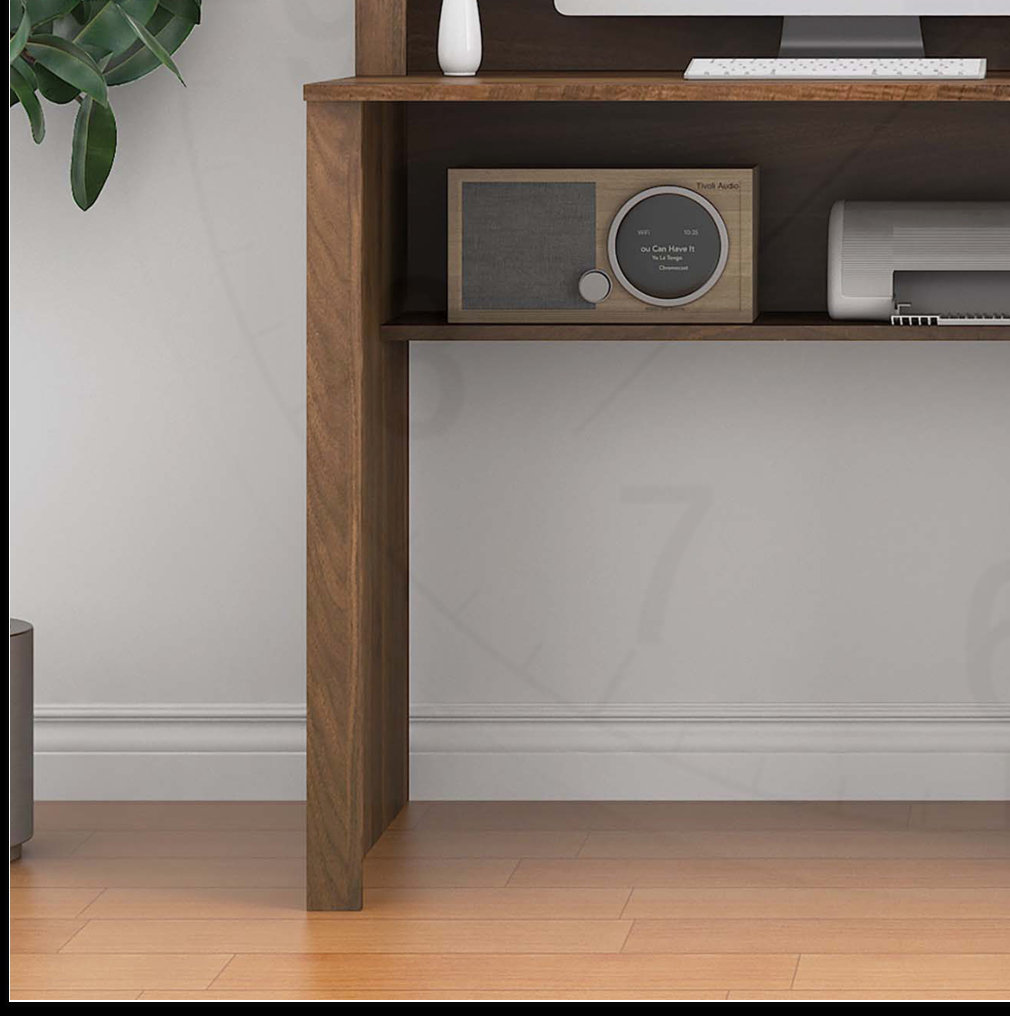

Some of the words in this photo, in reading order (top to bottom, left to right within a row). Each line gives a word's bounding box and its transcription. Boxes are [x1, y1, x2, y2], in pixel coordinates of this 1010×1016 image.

[697, 182, 717, 190] Tivoli
[717, 182, 740, 190] Audio
[652, 244, 667, 253] Can
[668, 244, 688, 253] Have
